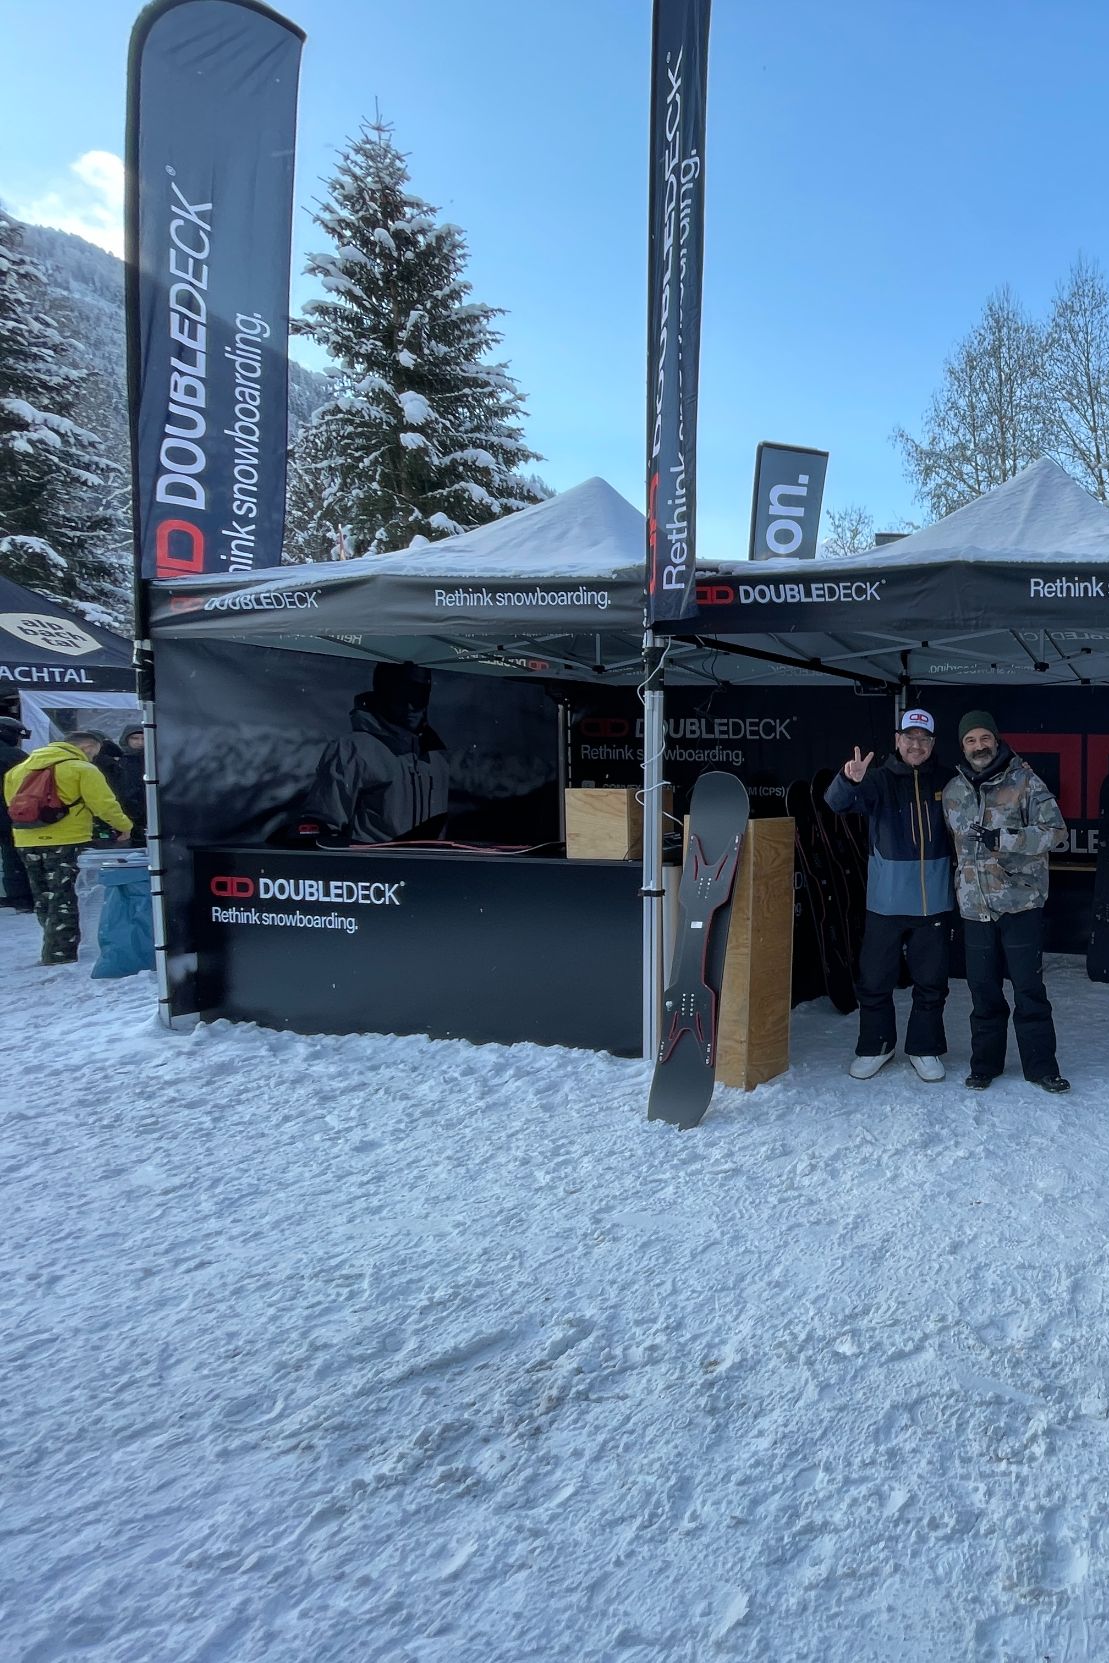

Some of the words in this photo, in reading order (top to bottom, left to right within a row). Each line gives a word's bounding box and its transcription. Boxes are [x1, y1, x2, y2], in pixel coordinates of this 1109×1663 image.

[223, 311, 271, 519] snowboarding.
[765, 473, 810, 559] on.
[219, 520, 257, 574] hink
[434, 587, 494, 607] Rethink
[495, 586, 612, 610] snowboarding.
[1029, 576, 1105, 598] Rethink
[16, 625, 88, 642] bach
[19, 618, 65, 632] alp
[40, 635, 82, 649] tal
[0, 665, 95, 684] ACHTAL
[581, 744, 635, 761] Rethink
[636, 746, 745, 766] swboarding.
[211, 906, 261, 925] Rethink
[261, 910, 359, 934] snowboarding.
